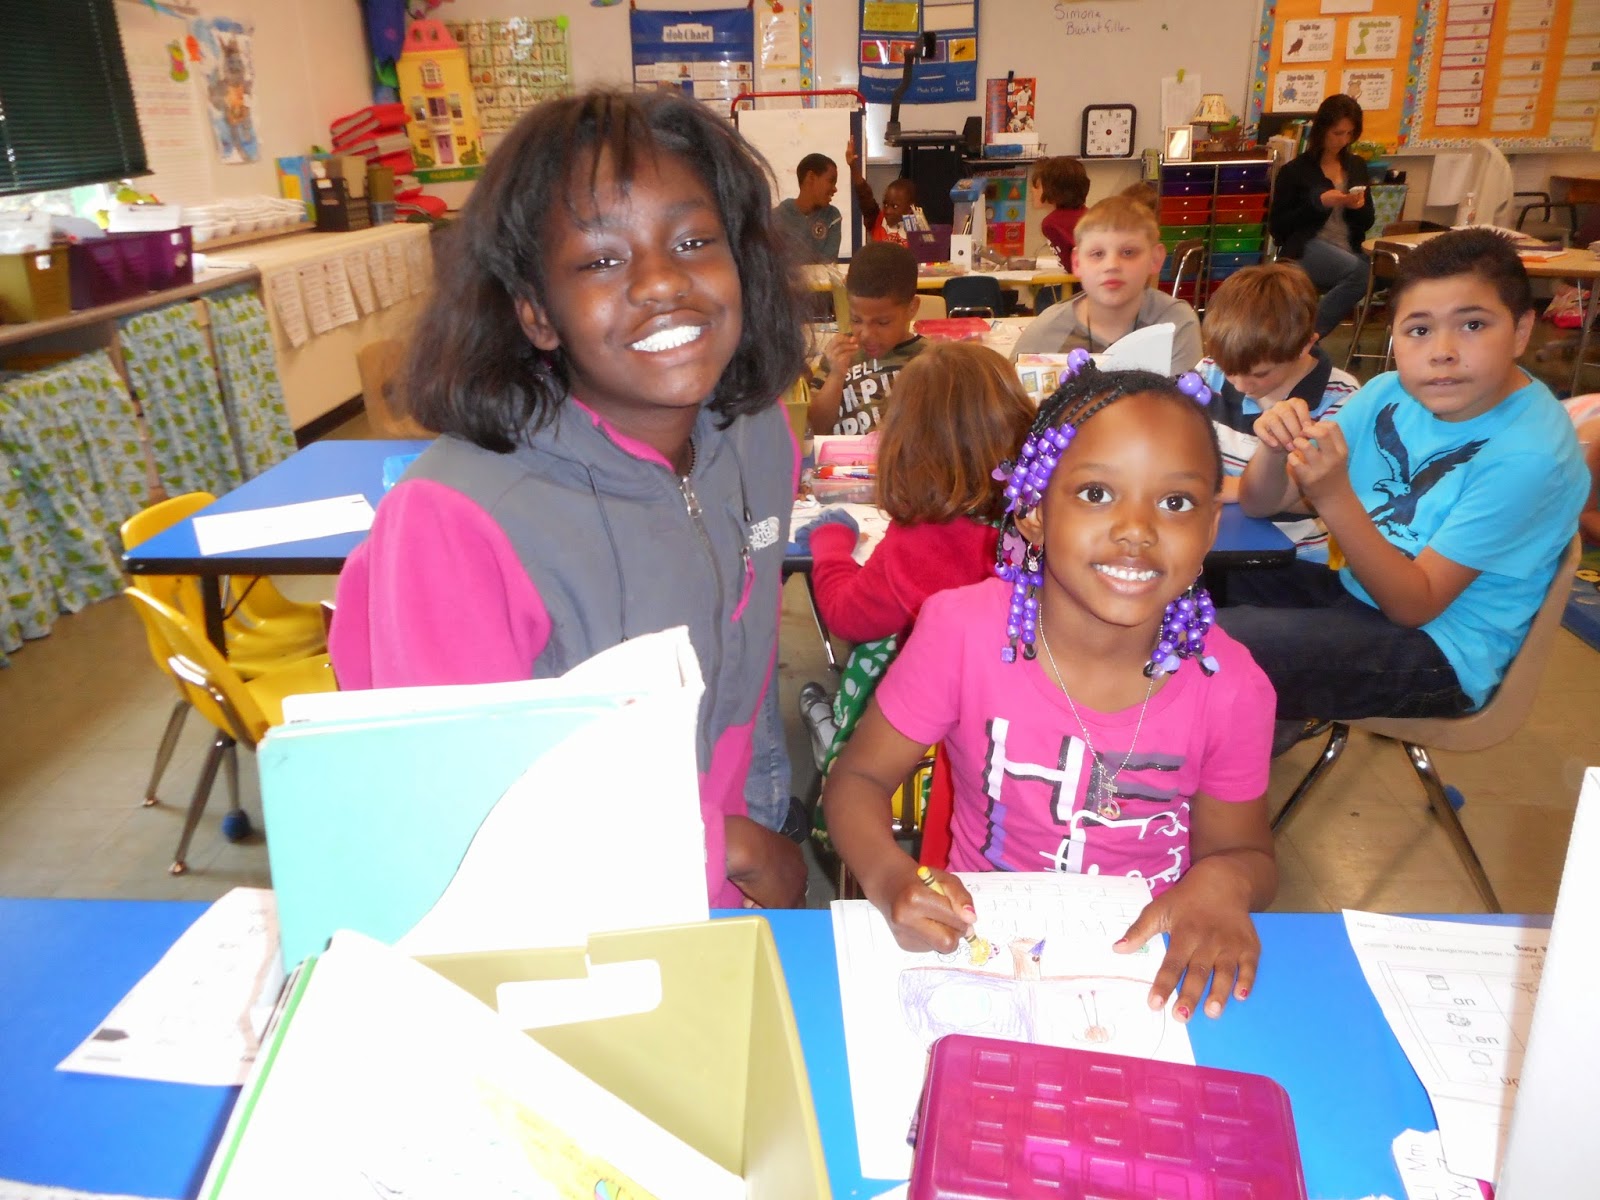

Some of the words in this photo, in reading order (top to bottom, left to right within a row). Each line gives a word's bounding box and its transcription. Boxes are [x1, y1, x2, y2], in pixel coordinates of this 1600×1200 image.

[1054, 3, 1101, 20] Simone
[684, 28, 710, 40] Chart
[1453, 997, 1476, 1006] an
